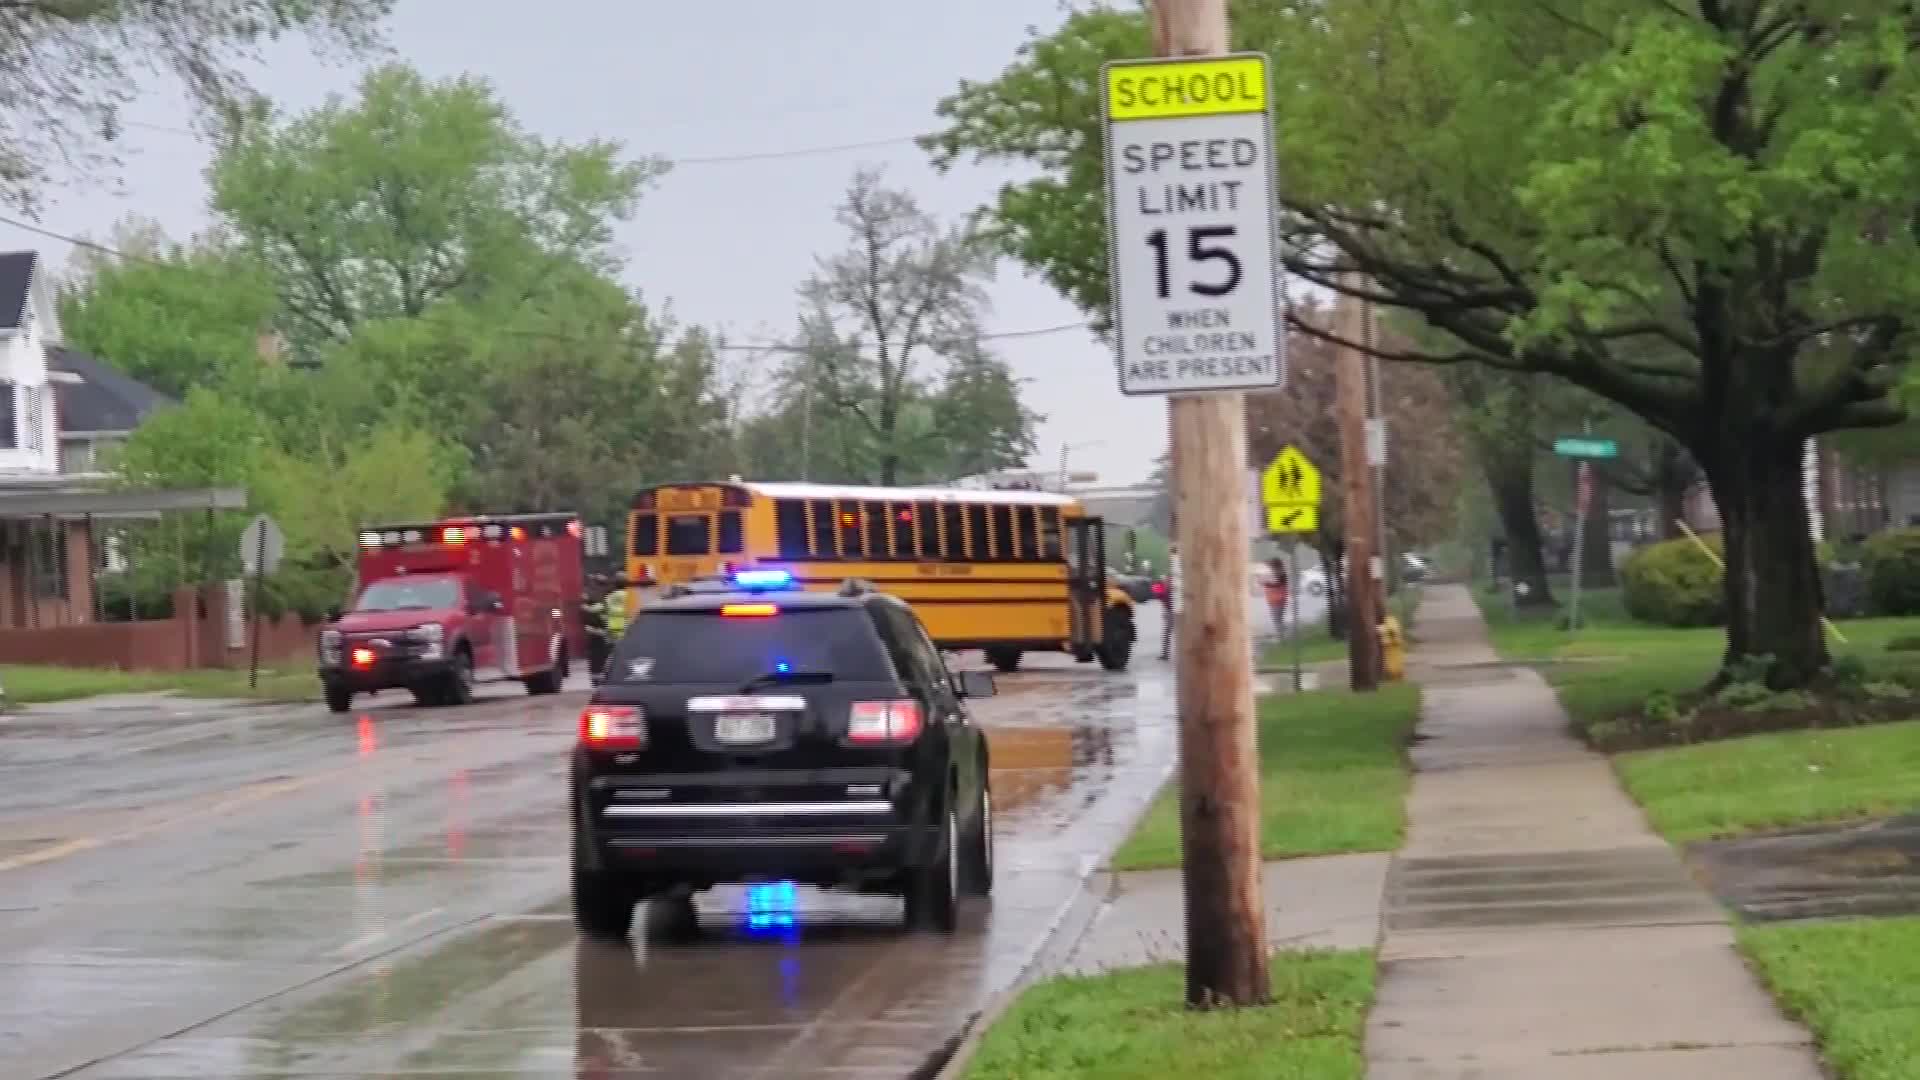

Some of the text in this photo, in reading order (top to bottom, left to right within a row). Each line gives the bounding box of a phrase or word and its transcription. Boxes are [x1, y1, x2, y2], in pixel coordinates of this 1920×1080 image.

[1117, 72, 1257, 107] SCHOOL
[1122, 138, 1257, 173] SPEED
[1138, 181, 1242, 214] LIMIT
[1145, 225, 1243, 298] 15
[1167, 308, 1230, 329] WHEN
[1144, 331, 1255, 355] CHILDREN
[1127, 354, 1273, 381] ARE PRESENT
